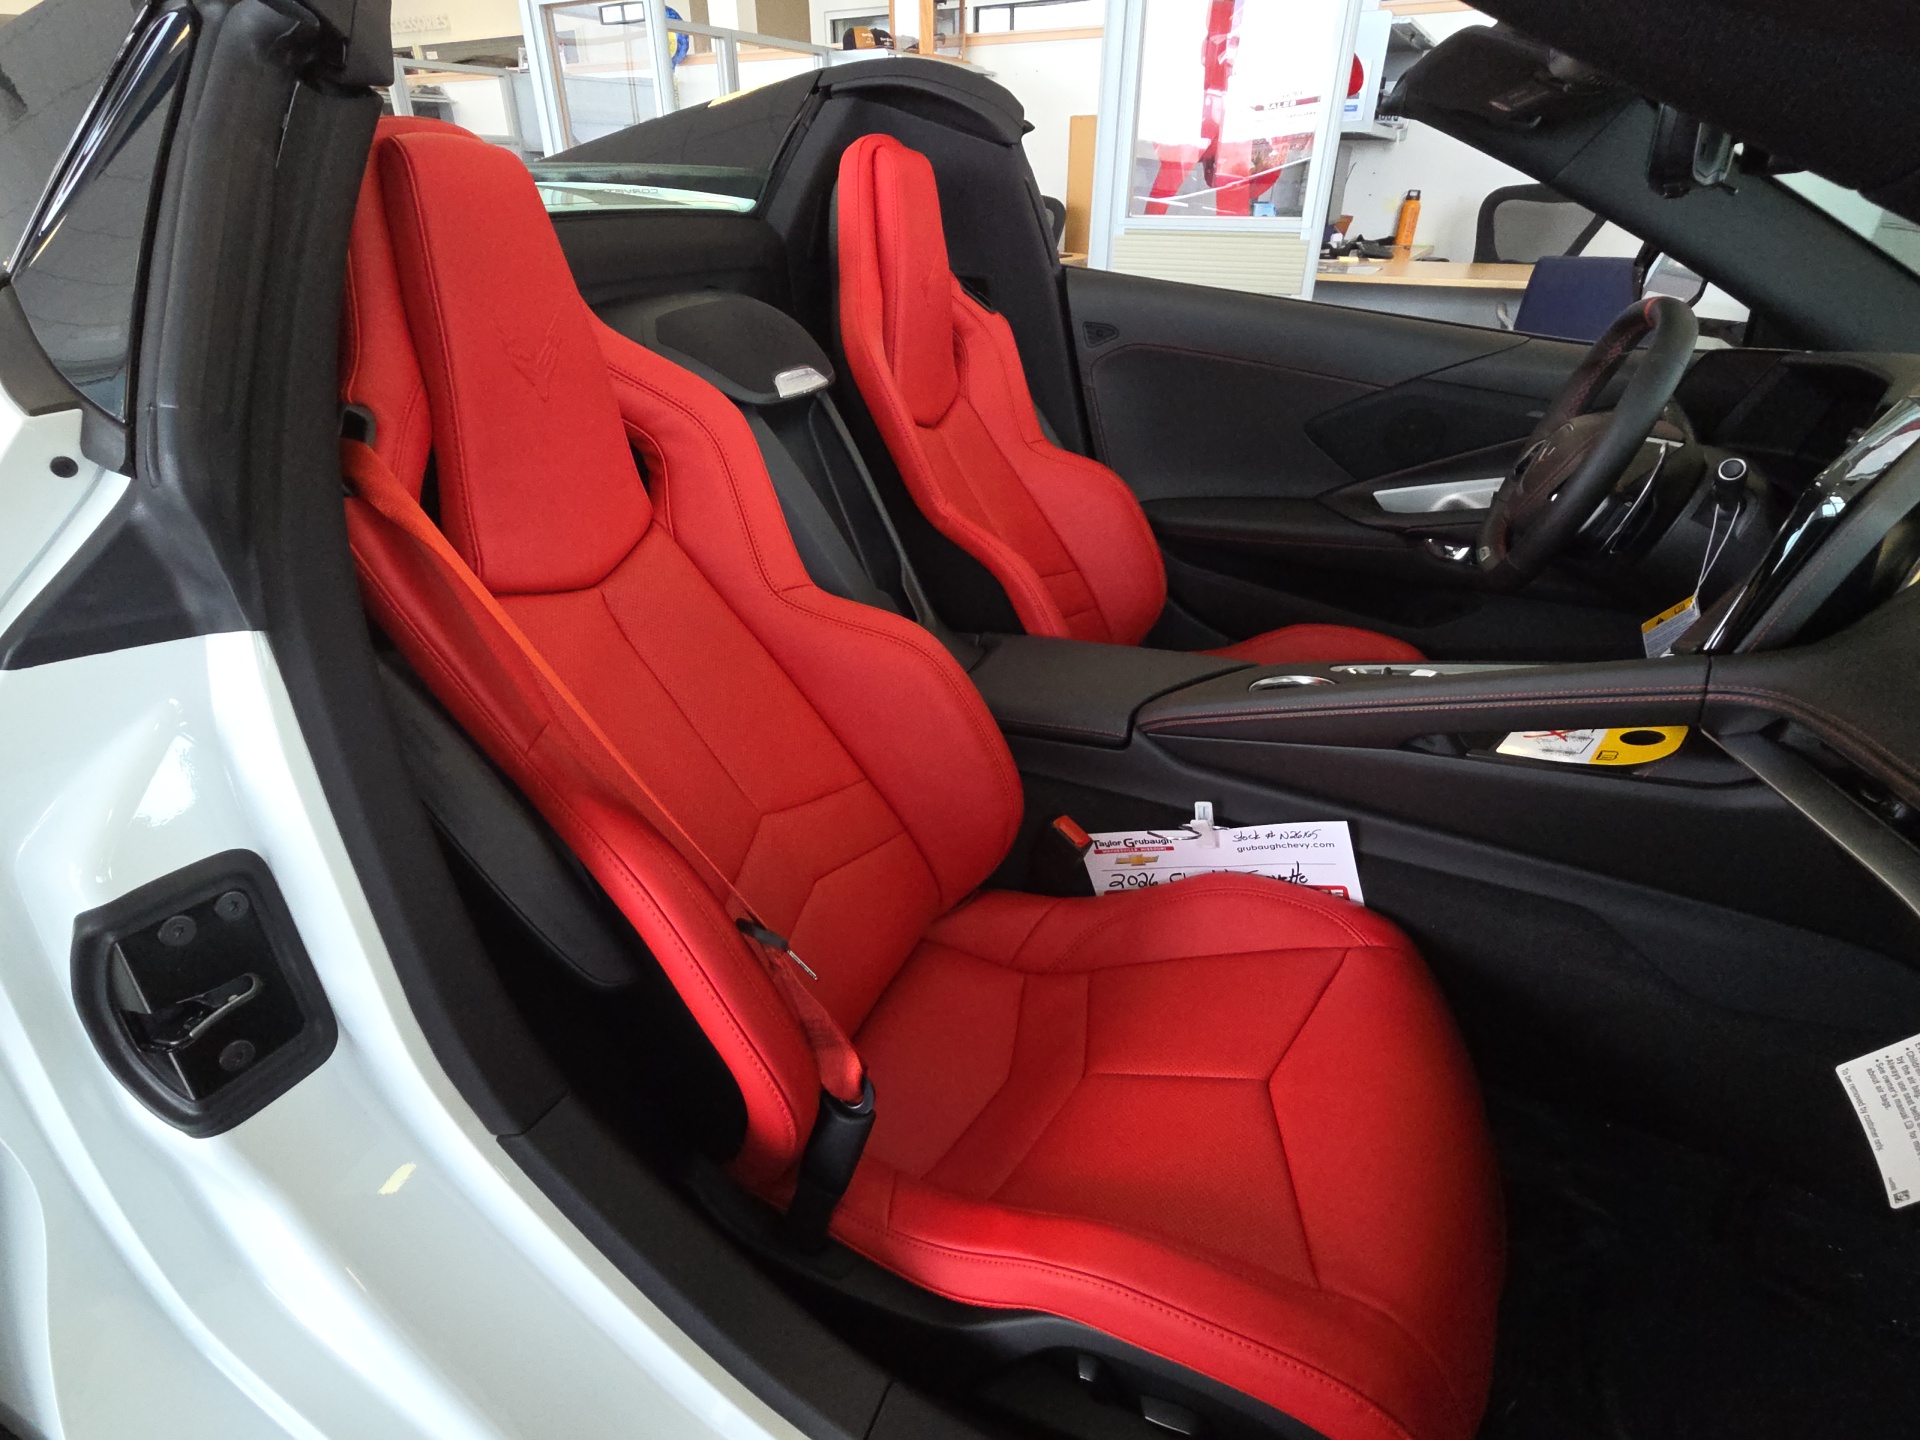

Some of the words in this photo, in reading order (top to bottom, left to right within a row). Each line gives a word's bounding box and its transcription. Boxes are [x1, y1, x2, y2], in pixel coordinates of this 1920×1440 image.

[1232, 830, 1261, 842] Stock
[1093, 839, 1122, 849] Taylor
[1123, 838, 1172, 848] Grubaugh
[1237, 842, 1335, 853] grubaughchevy.com
[1109, 872, 1158, 889] 2026
